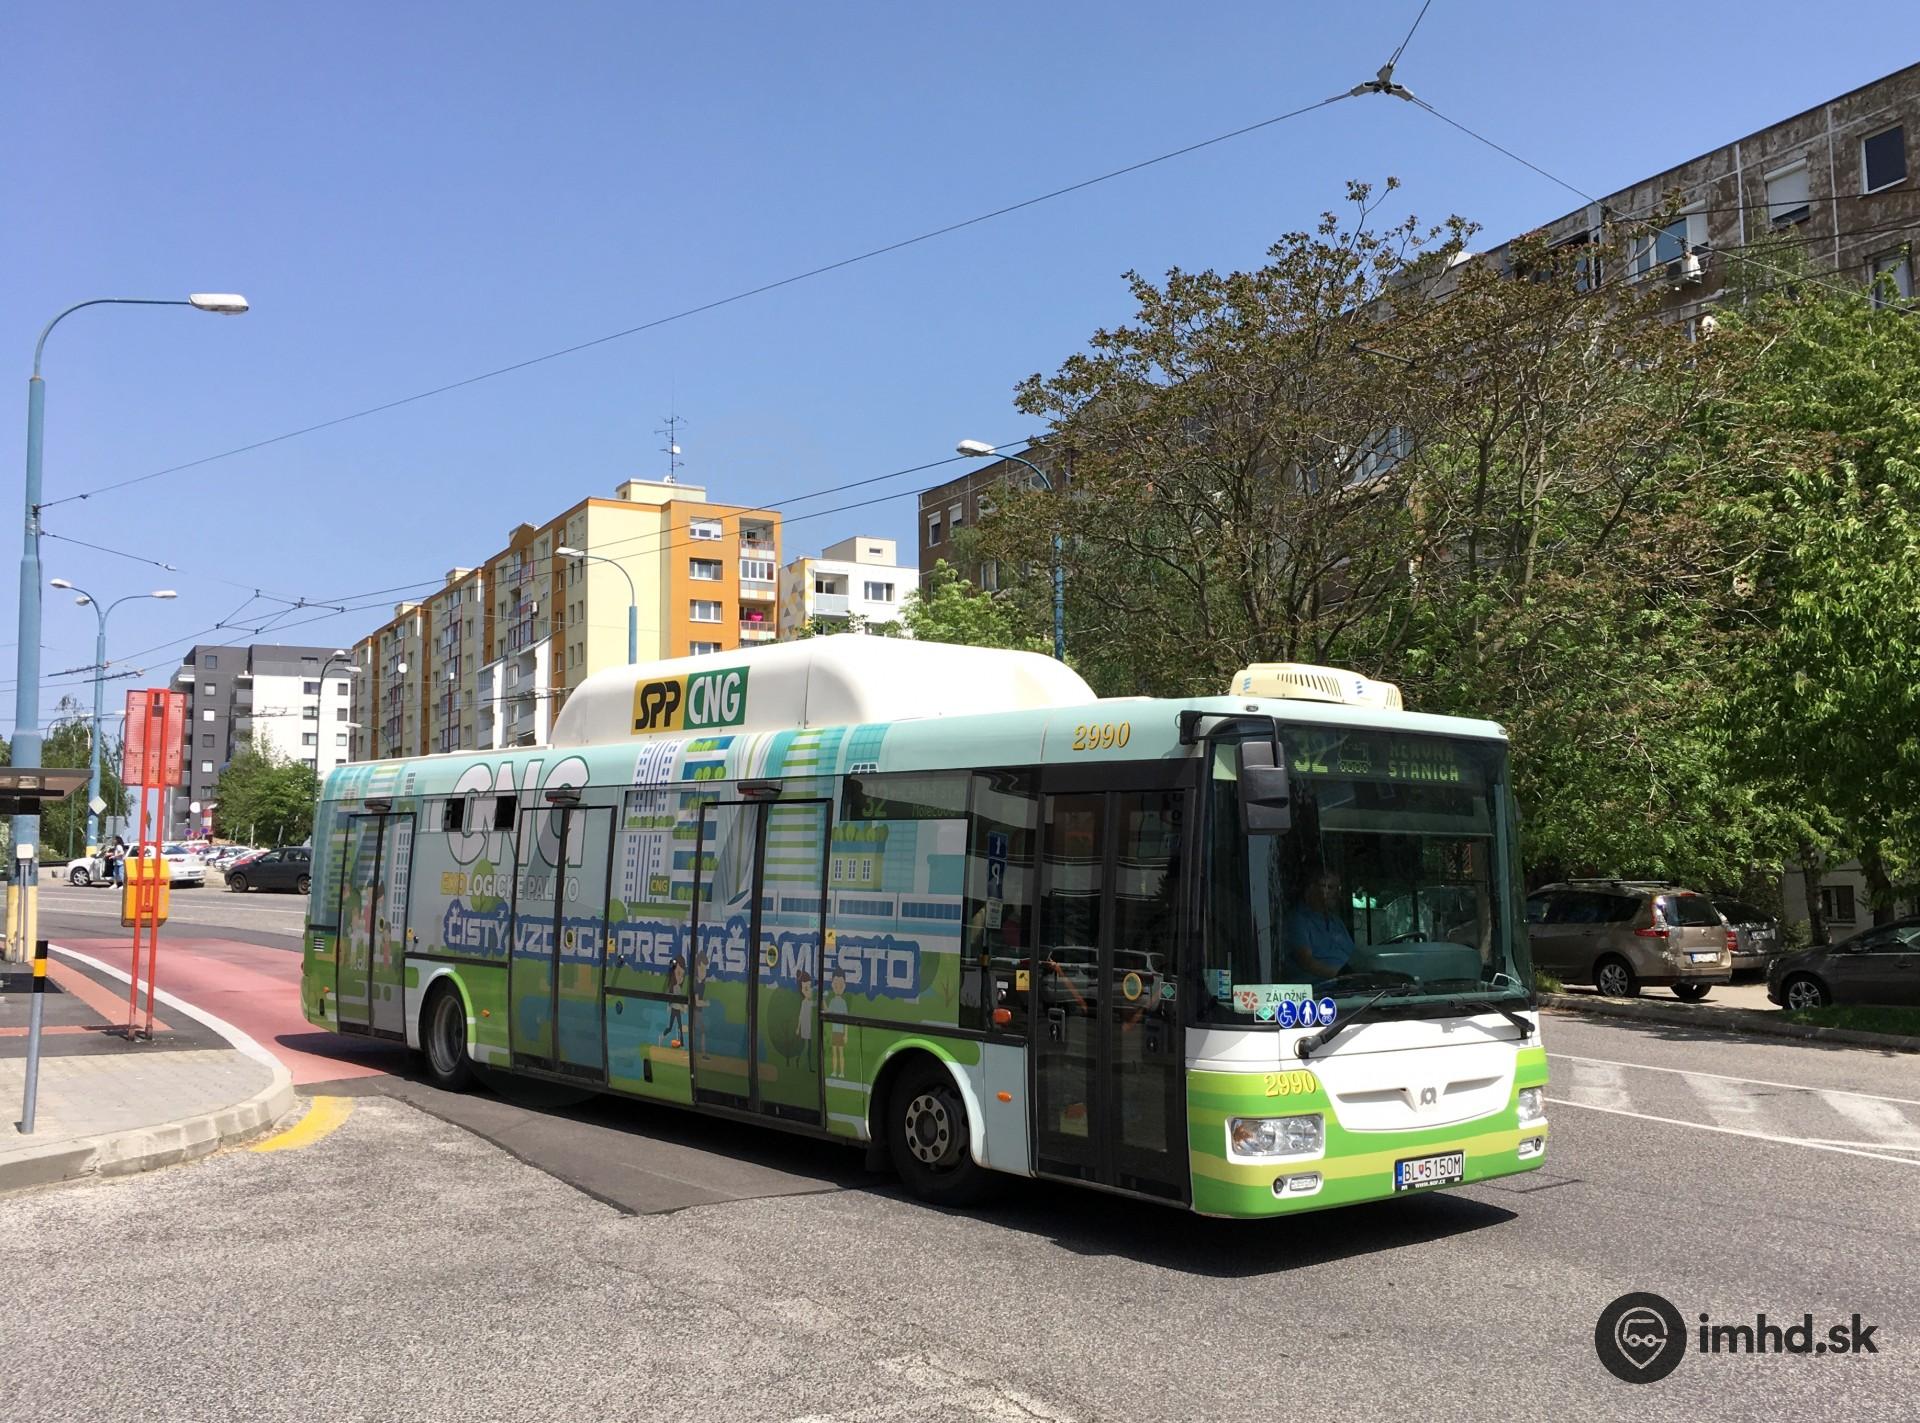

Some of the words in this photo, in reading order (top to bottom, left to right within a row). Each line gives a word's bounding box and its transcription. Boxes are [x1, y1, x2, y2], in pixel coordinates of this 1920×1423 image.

[635, 680, 681, 729] SPP
[688, 672, 741, 724] CNG
[1072, 720, 1131, 751] 2990
[1388, 760, 1460, 782] STANICA
[447, 755, 590, 868] CNG
[650, 879, 669, 892] CNG
[617, 930, 674, 966] PRE
[1263, 1071, 1316, 1097] 2990
[1404, 1162, 1419, 1182] BL
[1424, 1155, 1461, 1178] 5150M
